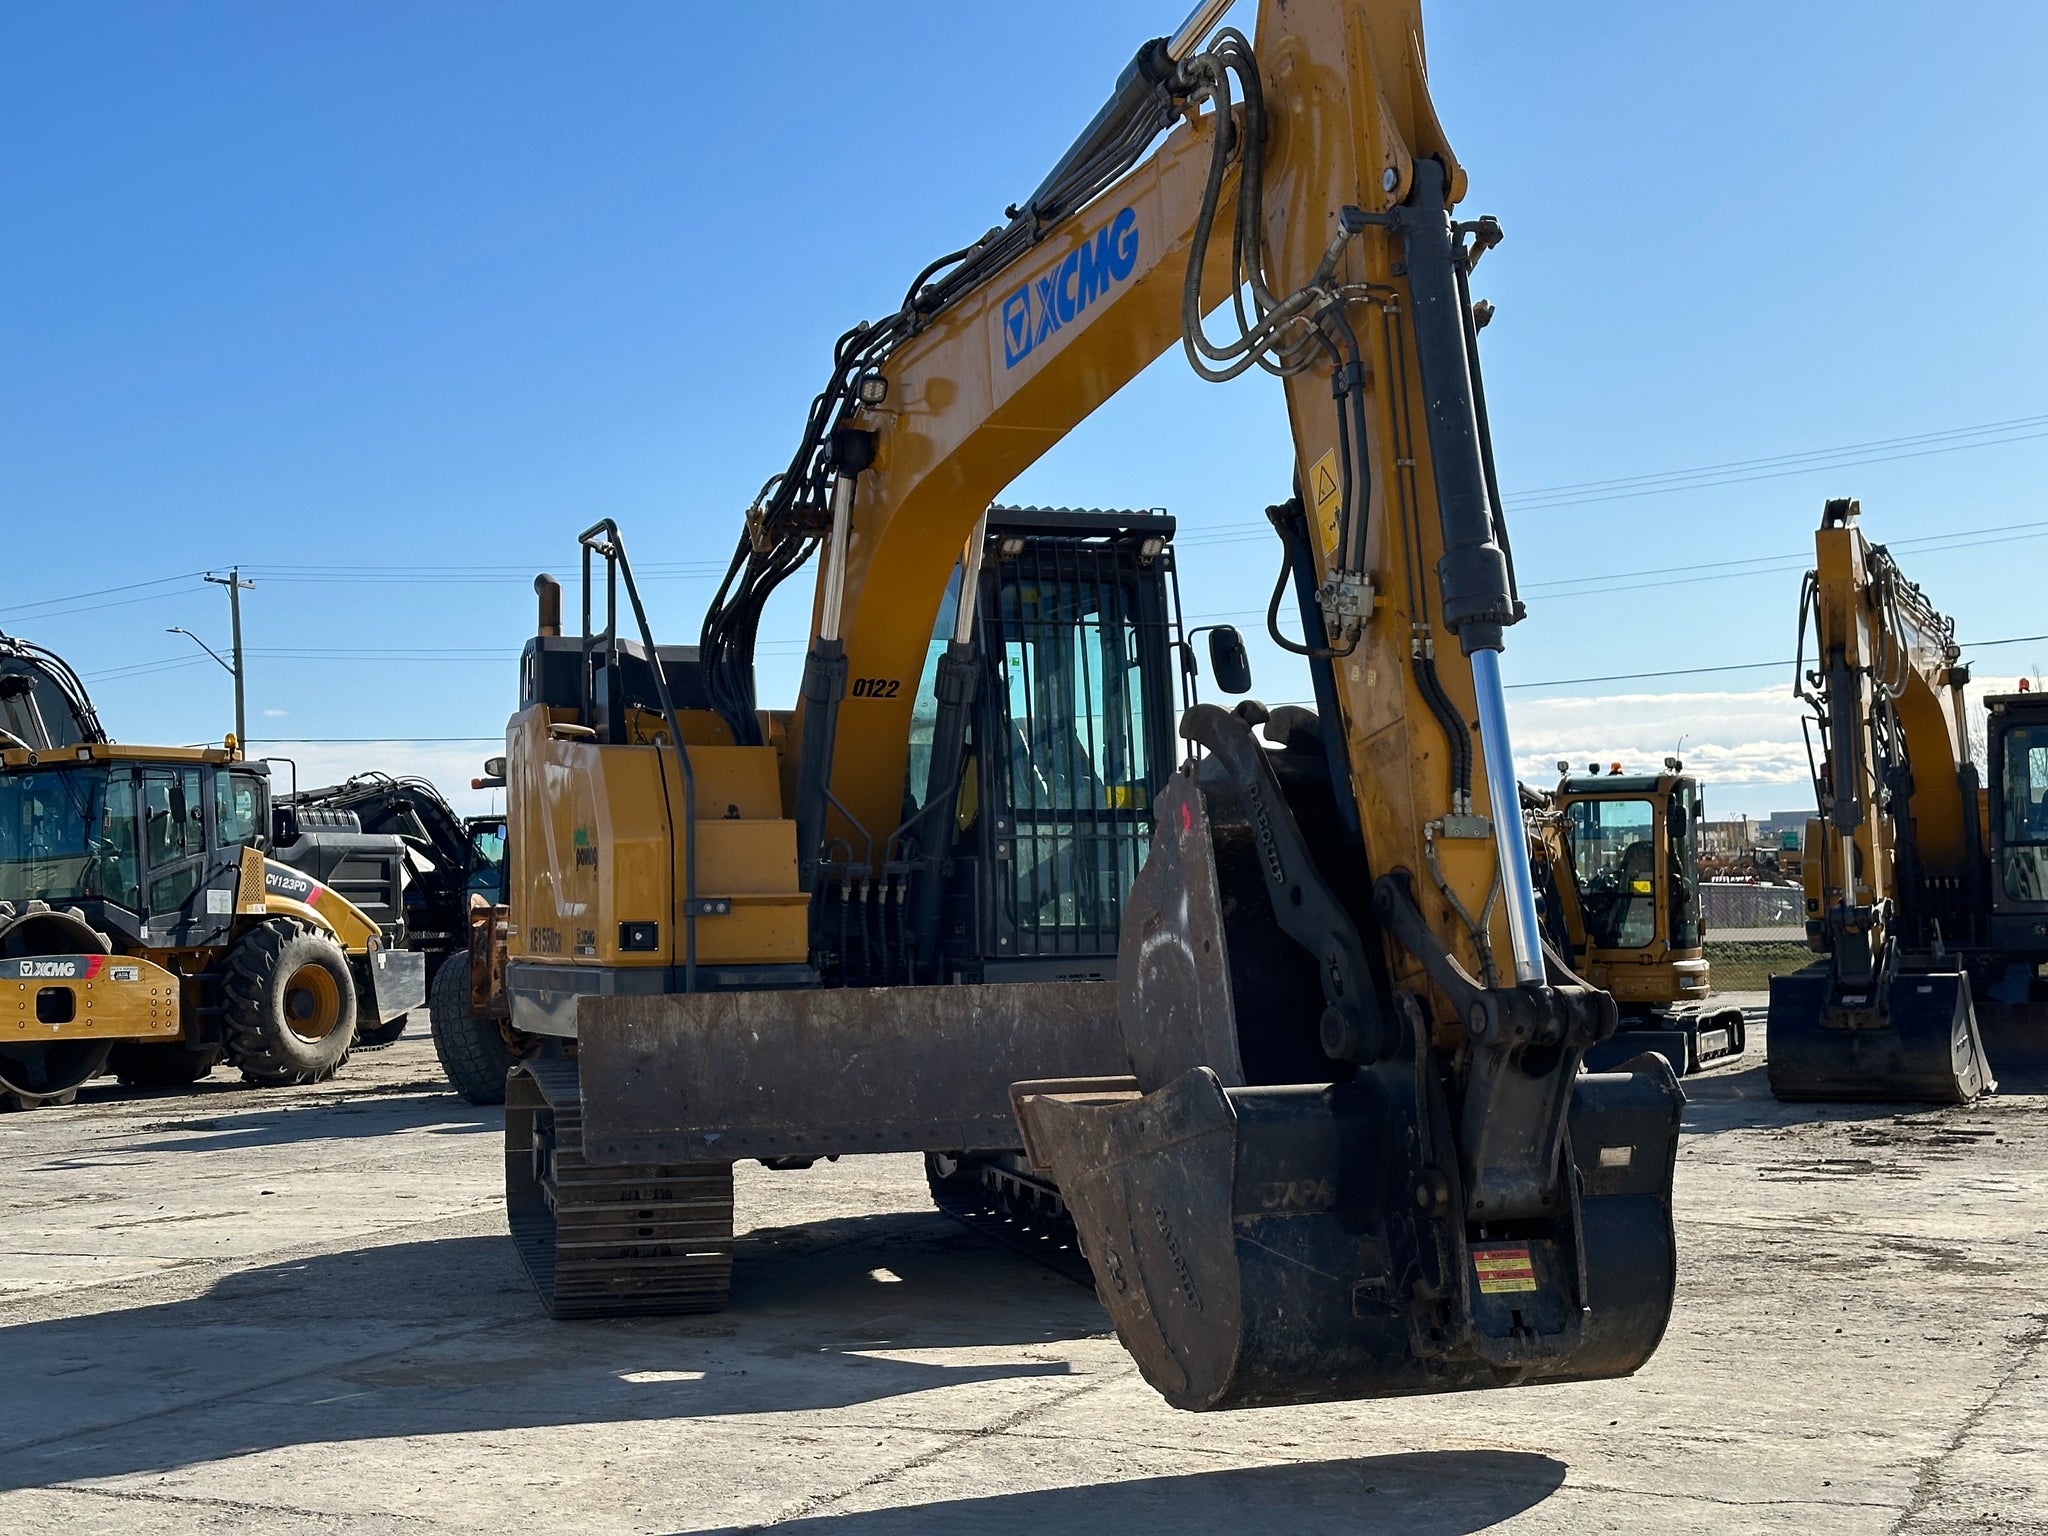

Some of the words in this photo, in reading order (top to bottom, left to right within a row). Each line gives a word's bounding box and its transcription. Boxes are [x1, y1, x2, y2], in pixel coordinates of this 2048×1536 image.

[1032, 206, 1139, 350] XCMG
[852, 678, 900, 698] 0122
[265, 873, 307, 892] CV123PD
[33, 962, 76, 976] XCMG
